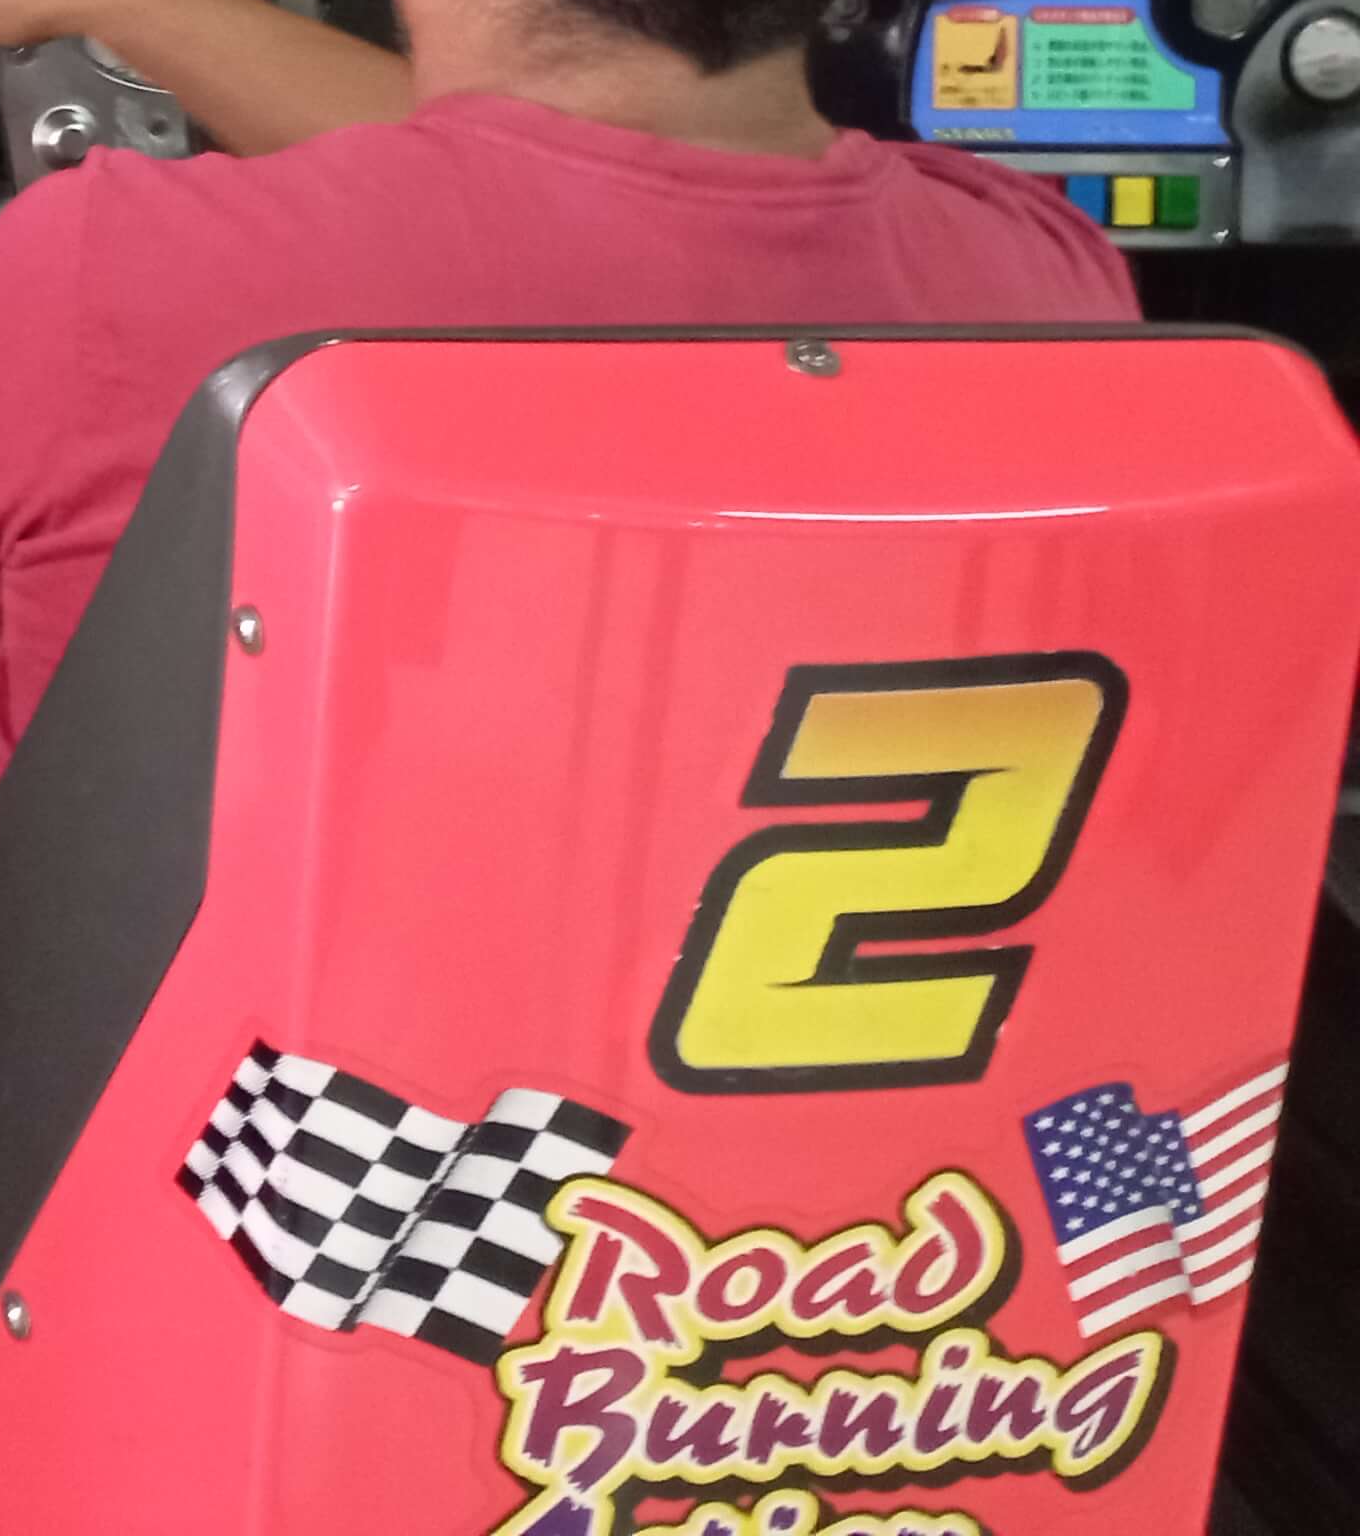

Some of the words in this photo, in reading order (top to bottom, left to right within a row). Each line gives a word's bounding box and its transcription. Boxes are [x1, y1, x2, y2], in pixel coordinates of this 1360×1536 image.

[648, 650, 1129, 1095] 2
[567, 1189, 990, 1349] Road
[518, 1344, 1144, 1494] Burning
